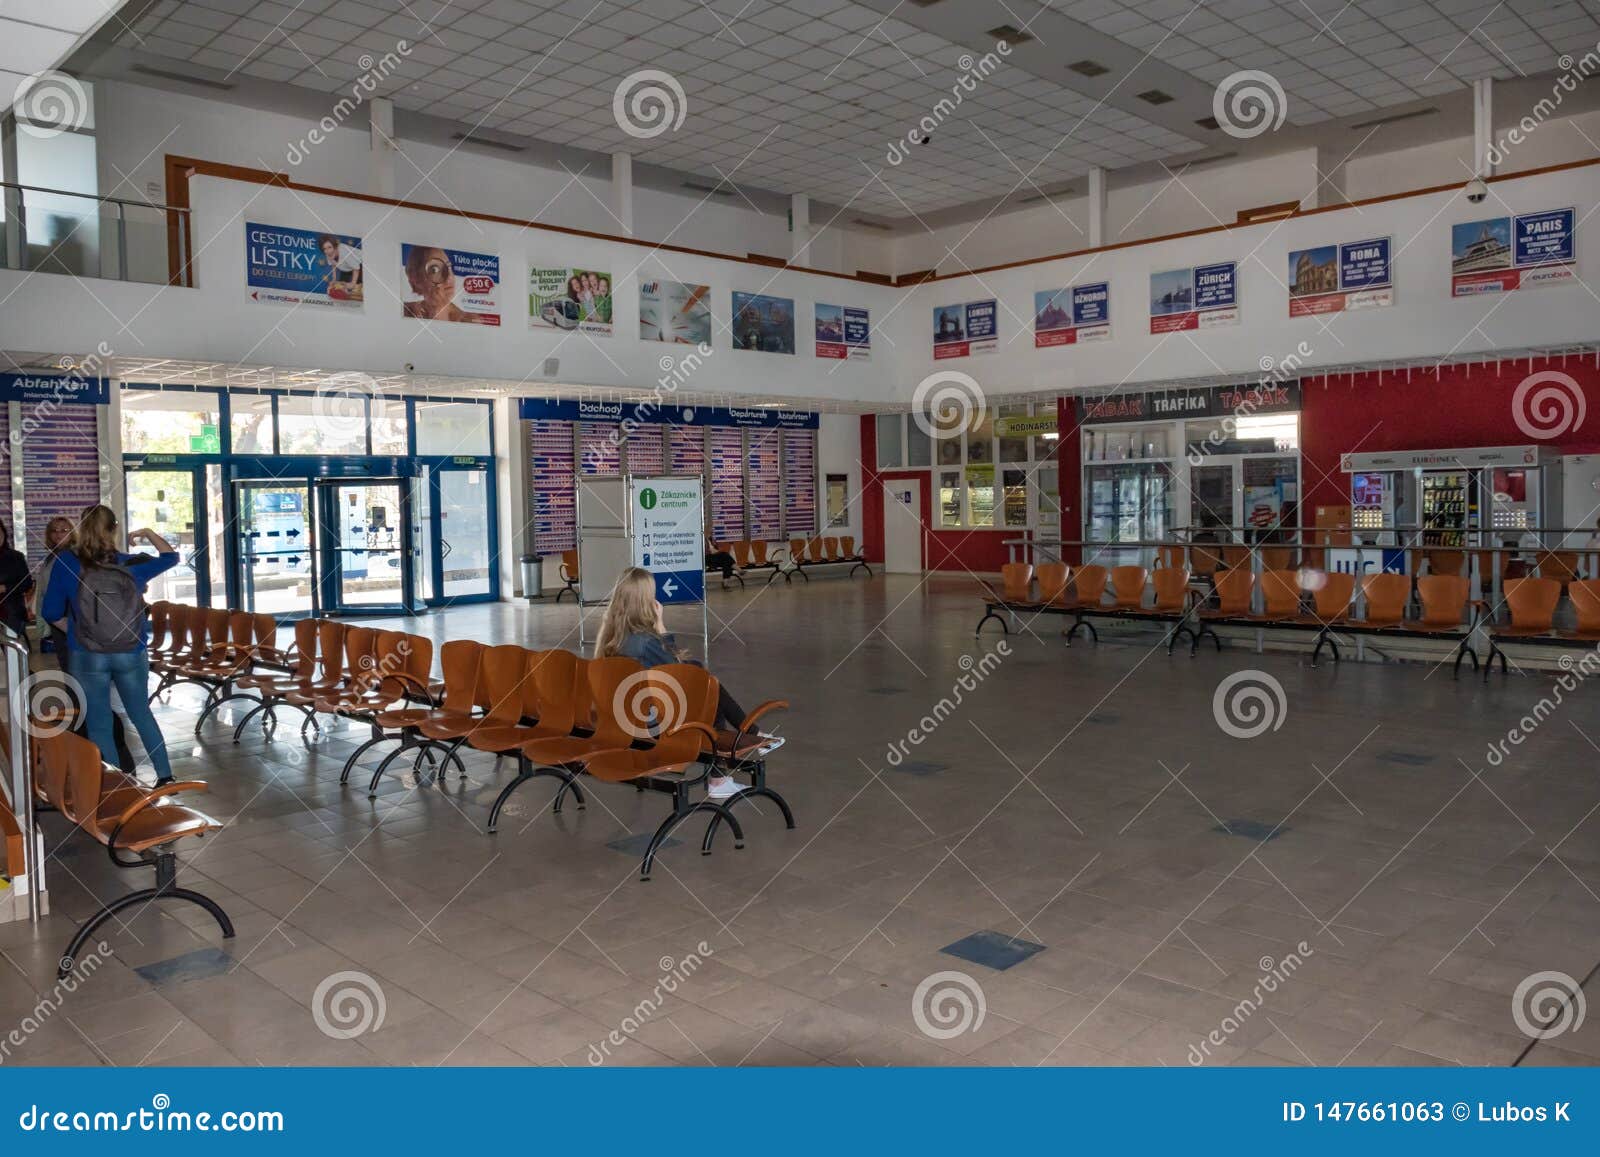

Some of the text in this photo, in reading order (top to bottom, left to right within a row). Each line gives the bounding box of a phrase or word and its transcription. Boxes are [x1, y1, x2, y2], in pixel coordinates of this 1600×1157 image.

[1526, 219, 1563, 234] PARIS
[251, 231, 317, 250] CESTOVNÉ
[251, 246, 317, 271] LÍSTKY
[1350, 247, 1380, 261] ROMA
[472, 279, 483, 288] 50
[1199, 272, 1231, 286] ZÜRICH
[1084, 386, 1289, 417] TABAK TRAFIKA TABAK
[579, 404, 622, 415] Odchody
[661, 500, 688, 508] centrum
